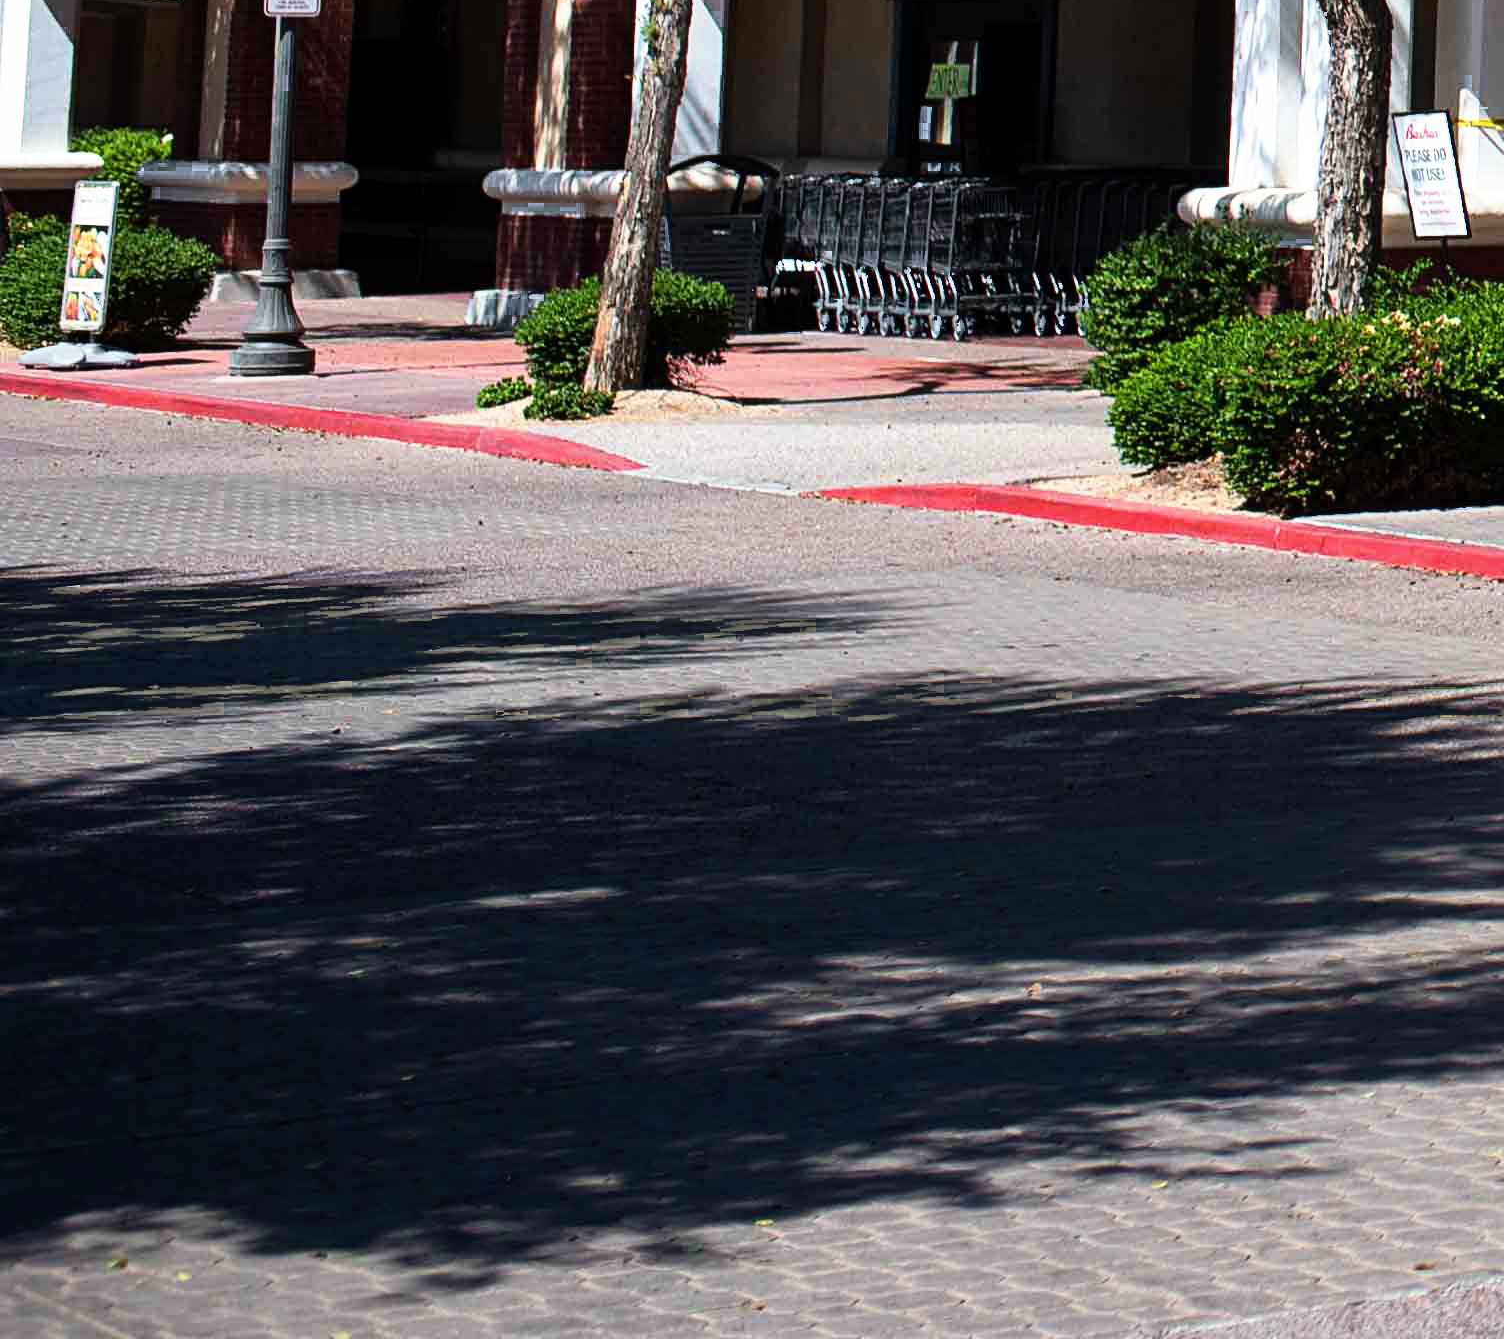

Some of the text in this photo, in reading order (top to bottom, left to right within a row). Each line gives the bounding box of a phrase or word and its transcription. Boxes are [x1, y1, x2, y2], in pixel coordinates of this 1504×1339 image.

[1404, 147, 1447, 163] PLEASE DO
[1411, 168, 1425, 181] NOT
